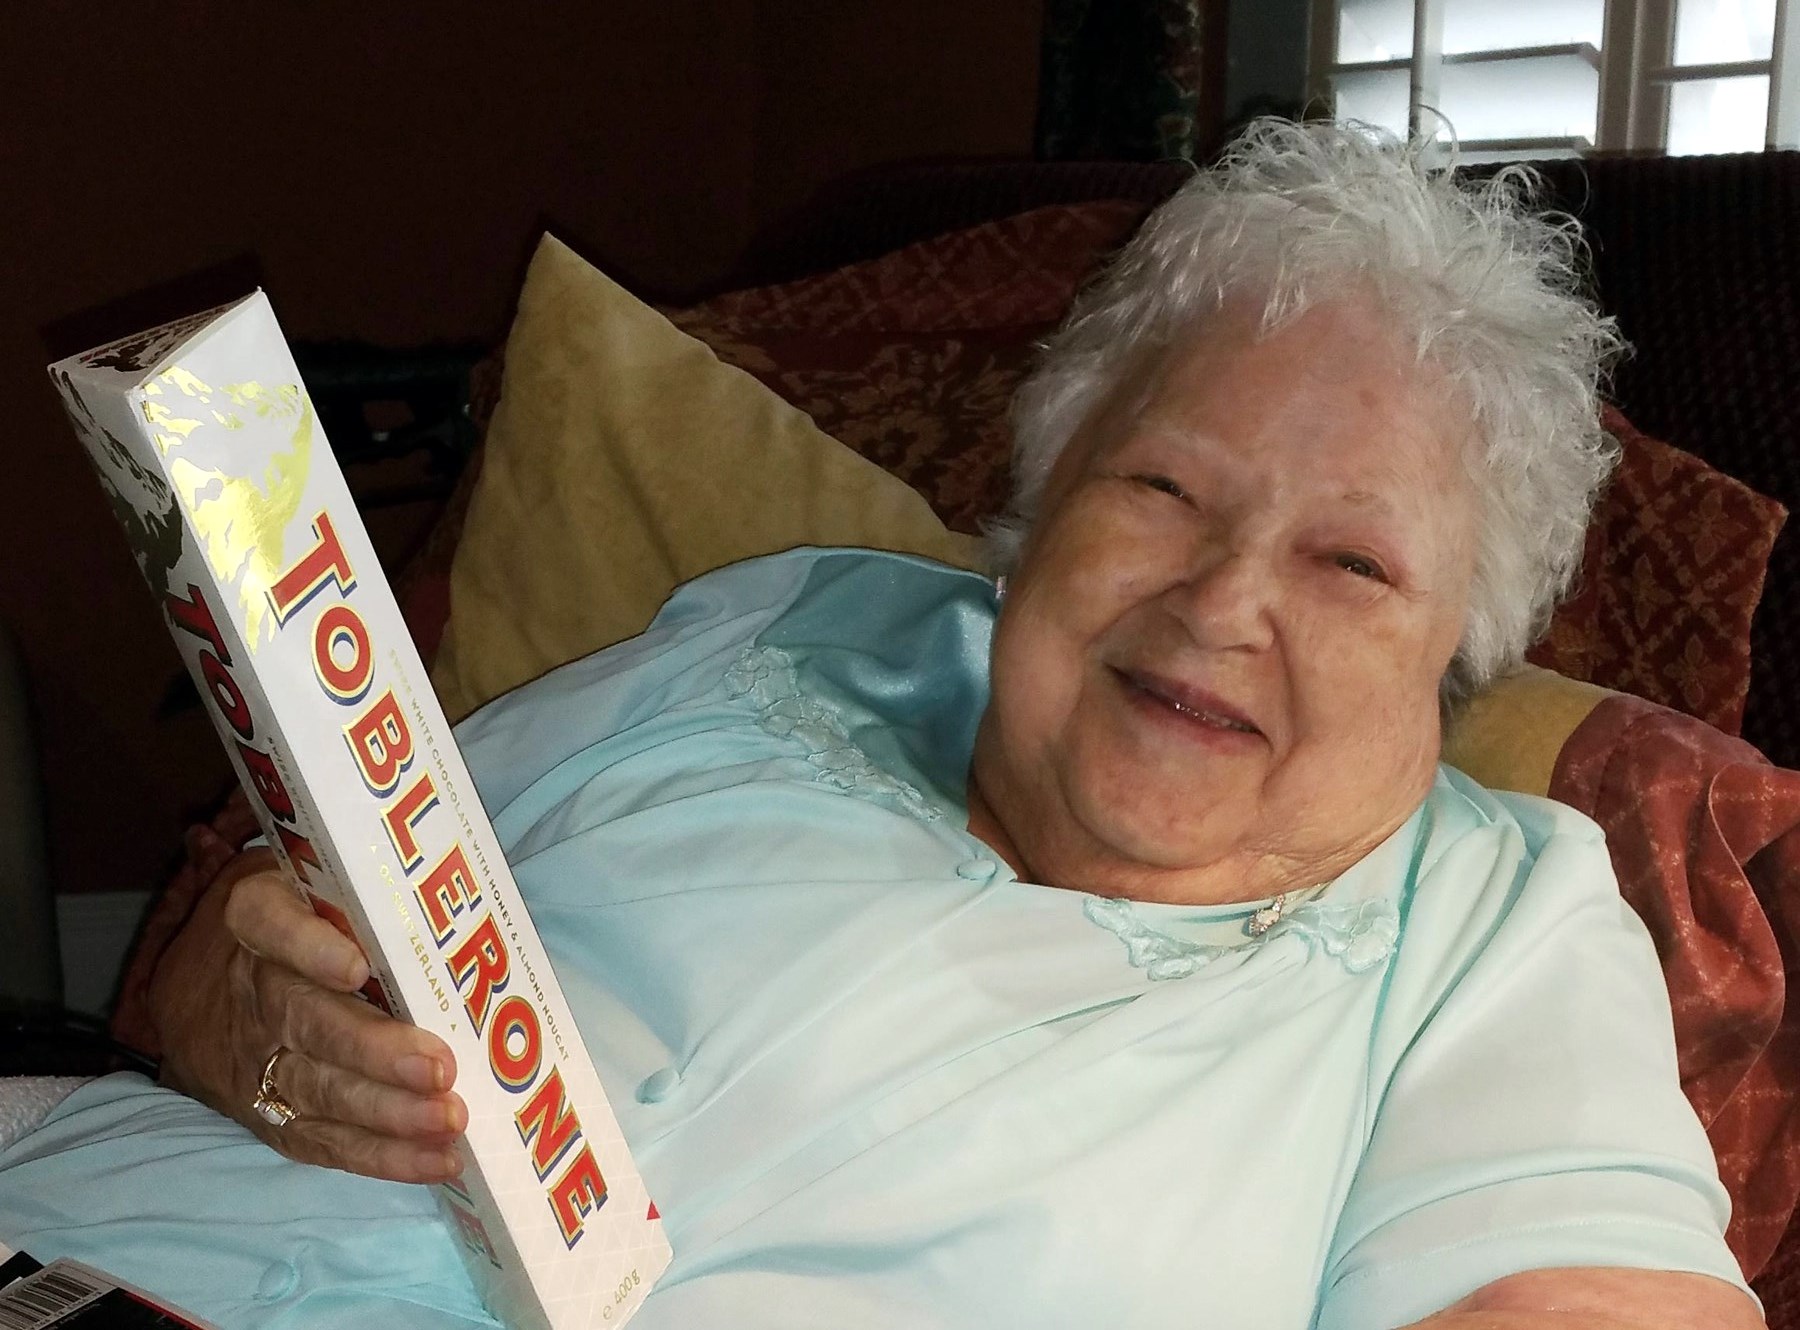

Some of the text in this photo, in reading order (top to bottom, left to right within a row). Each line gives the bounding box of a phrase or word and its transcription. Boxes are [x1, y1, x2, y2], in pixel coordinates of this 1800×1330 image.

[264, 508, 608, 1250] TOBLERONE
[393, 890, 450, 1013] SWITZERLAND
[411, 697, 434, 746] WHITE
[432, 748, 474, 838] CHOCOLATE
[472, 840, 490, 877] WITH
[488, 879, 513, 928] HONEY
[510, 932, 518, 941] &
[516, 945, 544, 1002] ALMOND
[542, 1004, 569, 1060] NOUGAT
